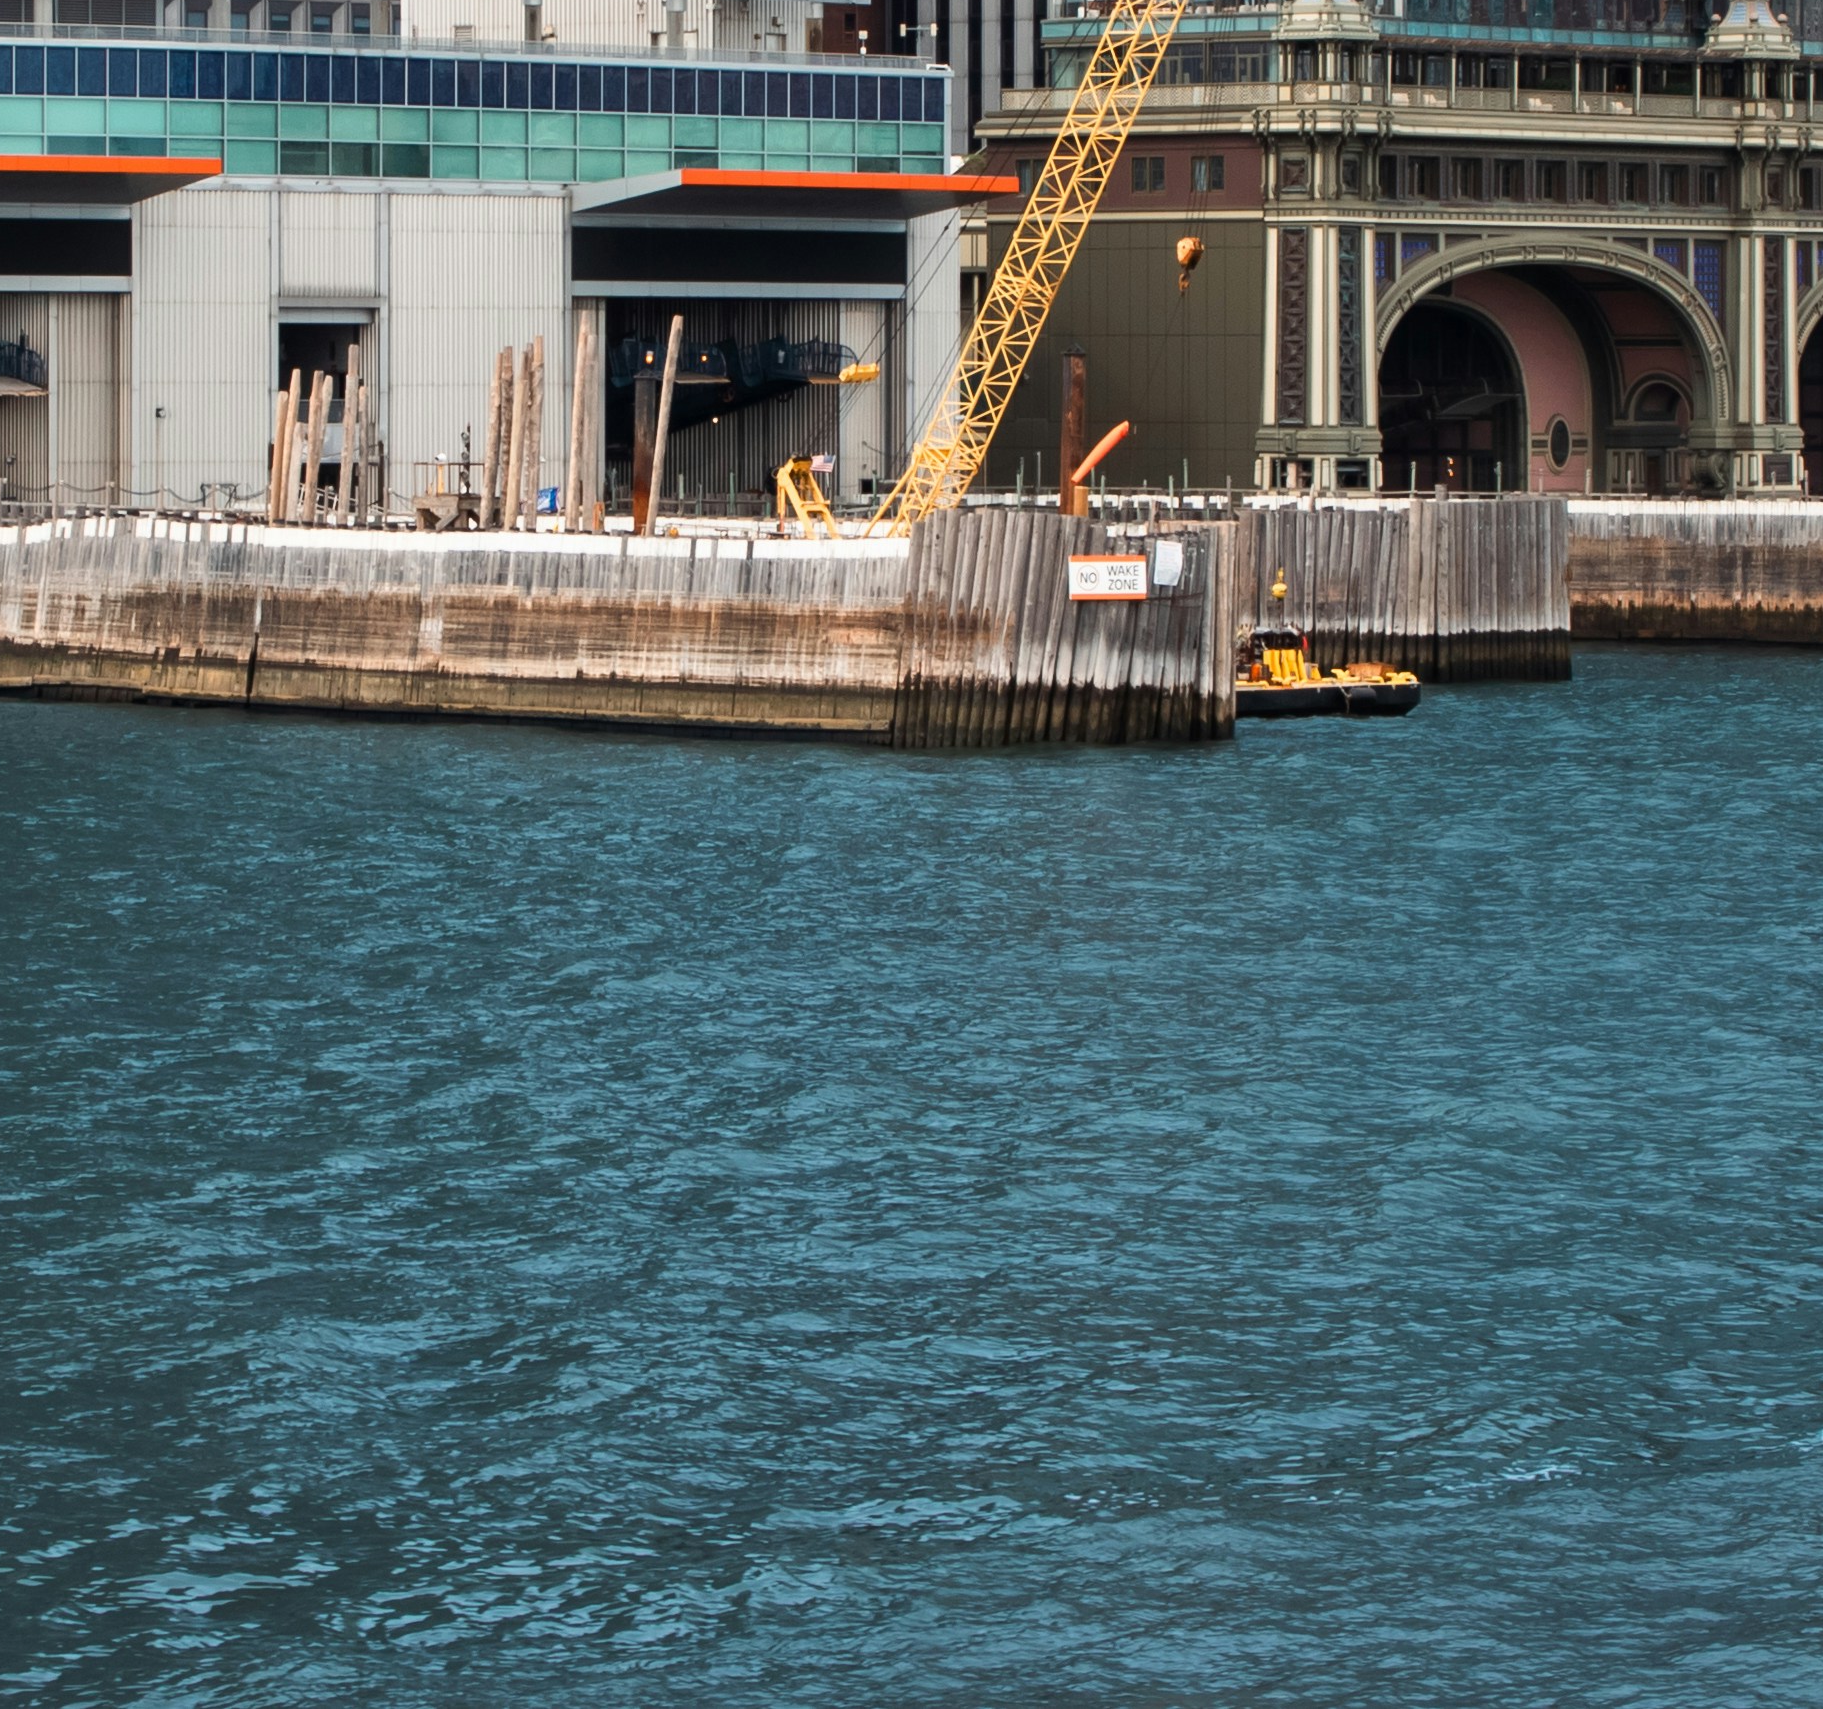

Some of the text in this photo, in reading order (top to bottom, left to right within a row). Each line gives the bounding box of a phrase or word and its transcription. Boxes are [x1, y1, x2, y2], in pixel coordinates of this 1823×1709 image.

[1107, 565, 1139, 577] WAKE
[1080, 572, 1097, 584] NO
[1108, 579, 1139, 591] ZONE
